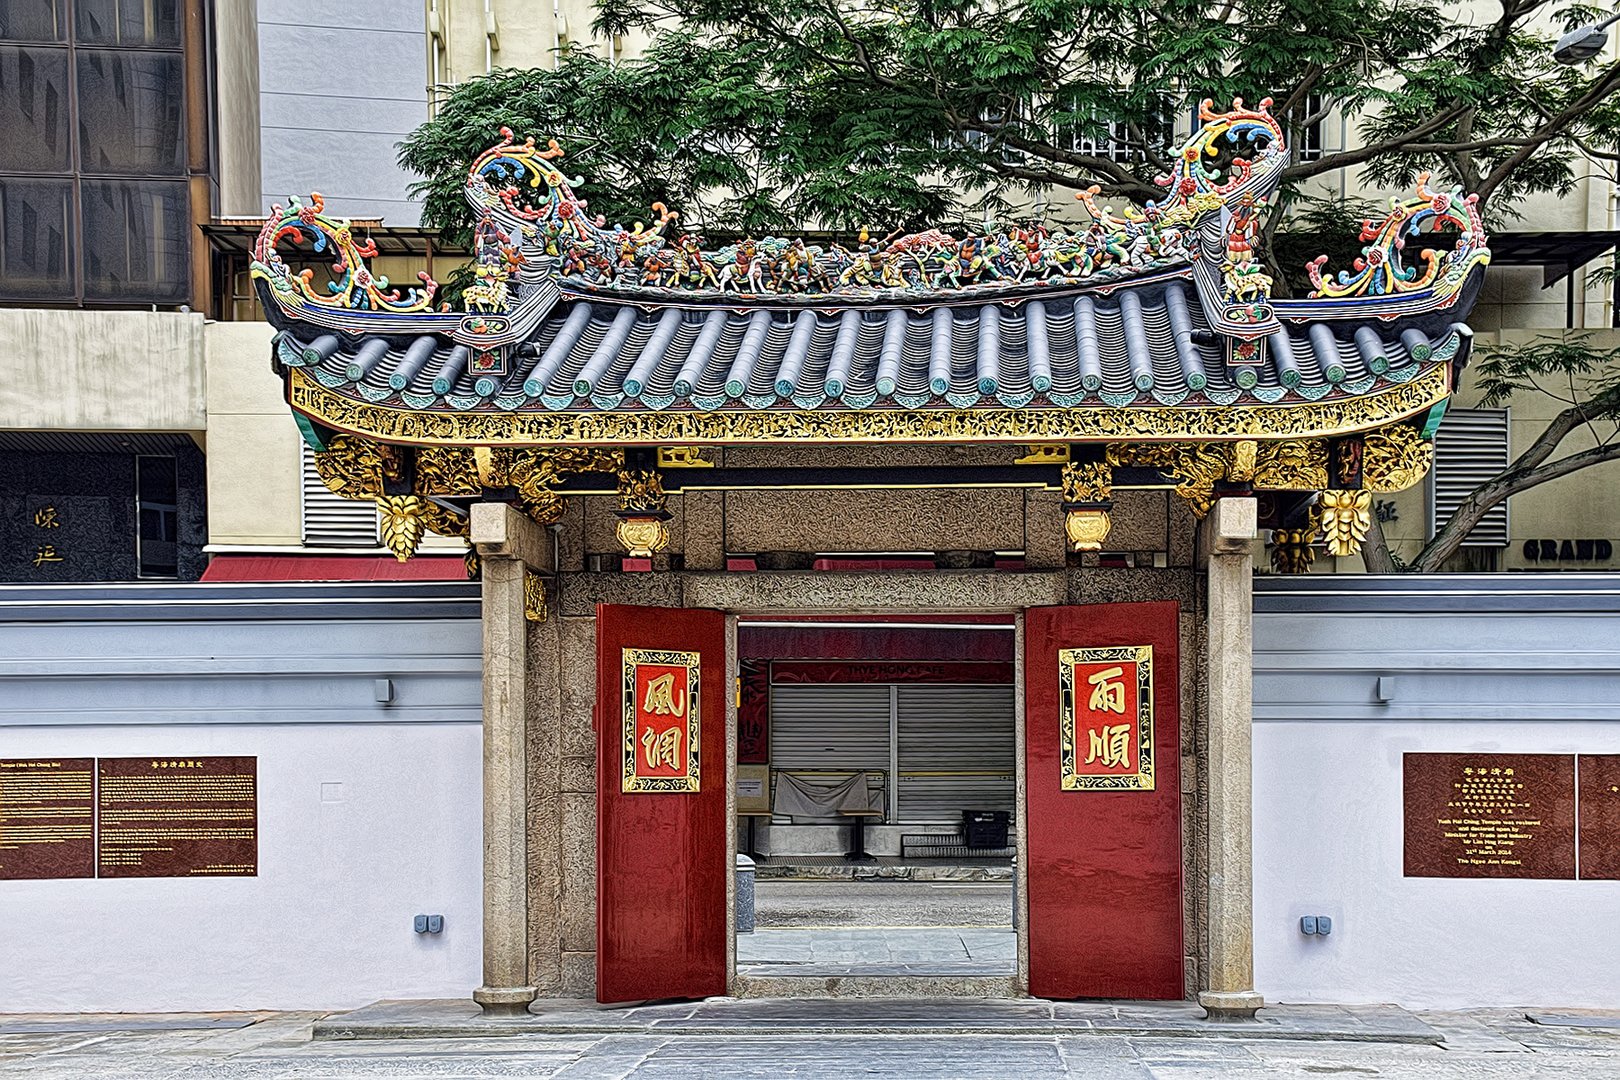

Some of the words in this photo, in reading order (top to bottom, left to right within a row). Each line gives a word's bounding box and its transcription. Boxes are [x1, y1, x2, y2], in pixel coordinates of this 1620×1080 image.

[1523, 539, 1613, 562] GRAND
[917, 665, 945, 674] CAFE
[641, 672, 685, 771] 風調
[1085, 666, 1131, 769] 雨順
